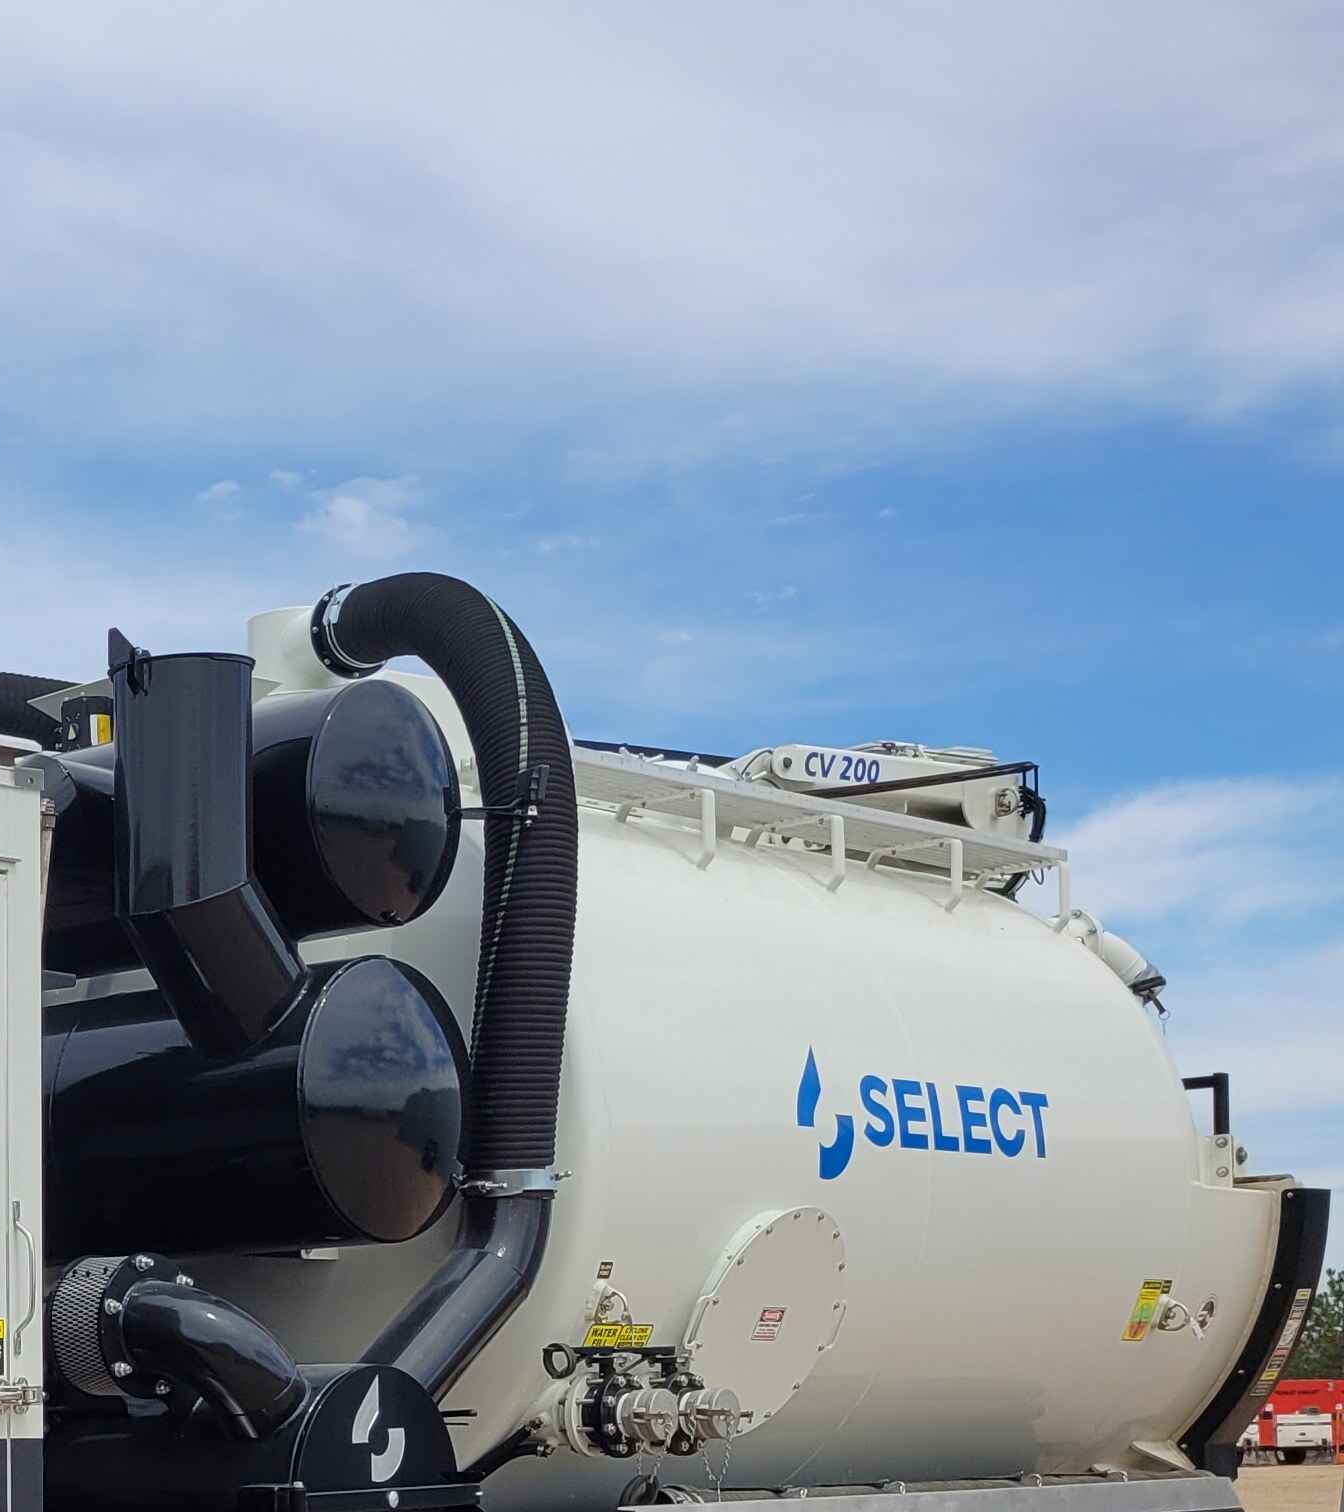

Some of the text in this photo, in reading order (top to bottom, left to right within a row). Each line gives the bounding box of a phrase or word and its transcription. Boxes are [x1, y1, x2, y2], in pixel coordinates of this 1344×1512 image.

[804, 751, 881, 785] CV 200
[859, 1073, 1050, 1158] SELECT
[591, 1327, 618, 1338] WATER
